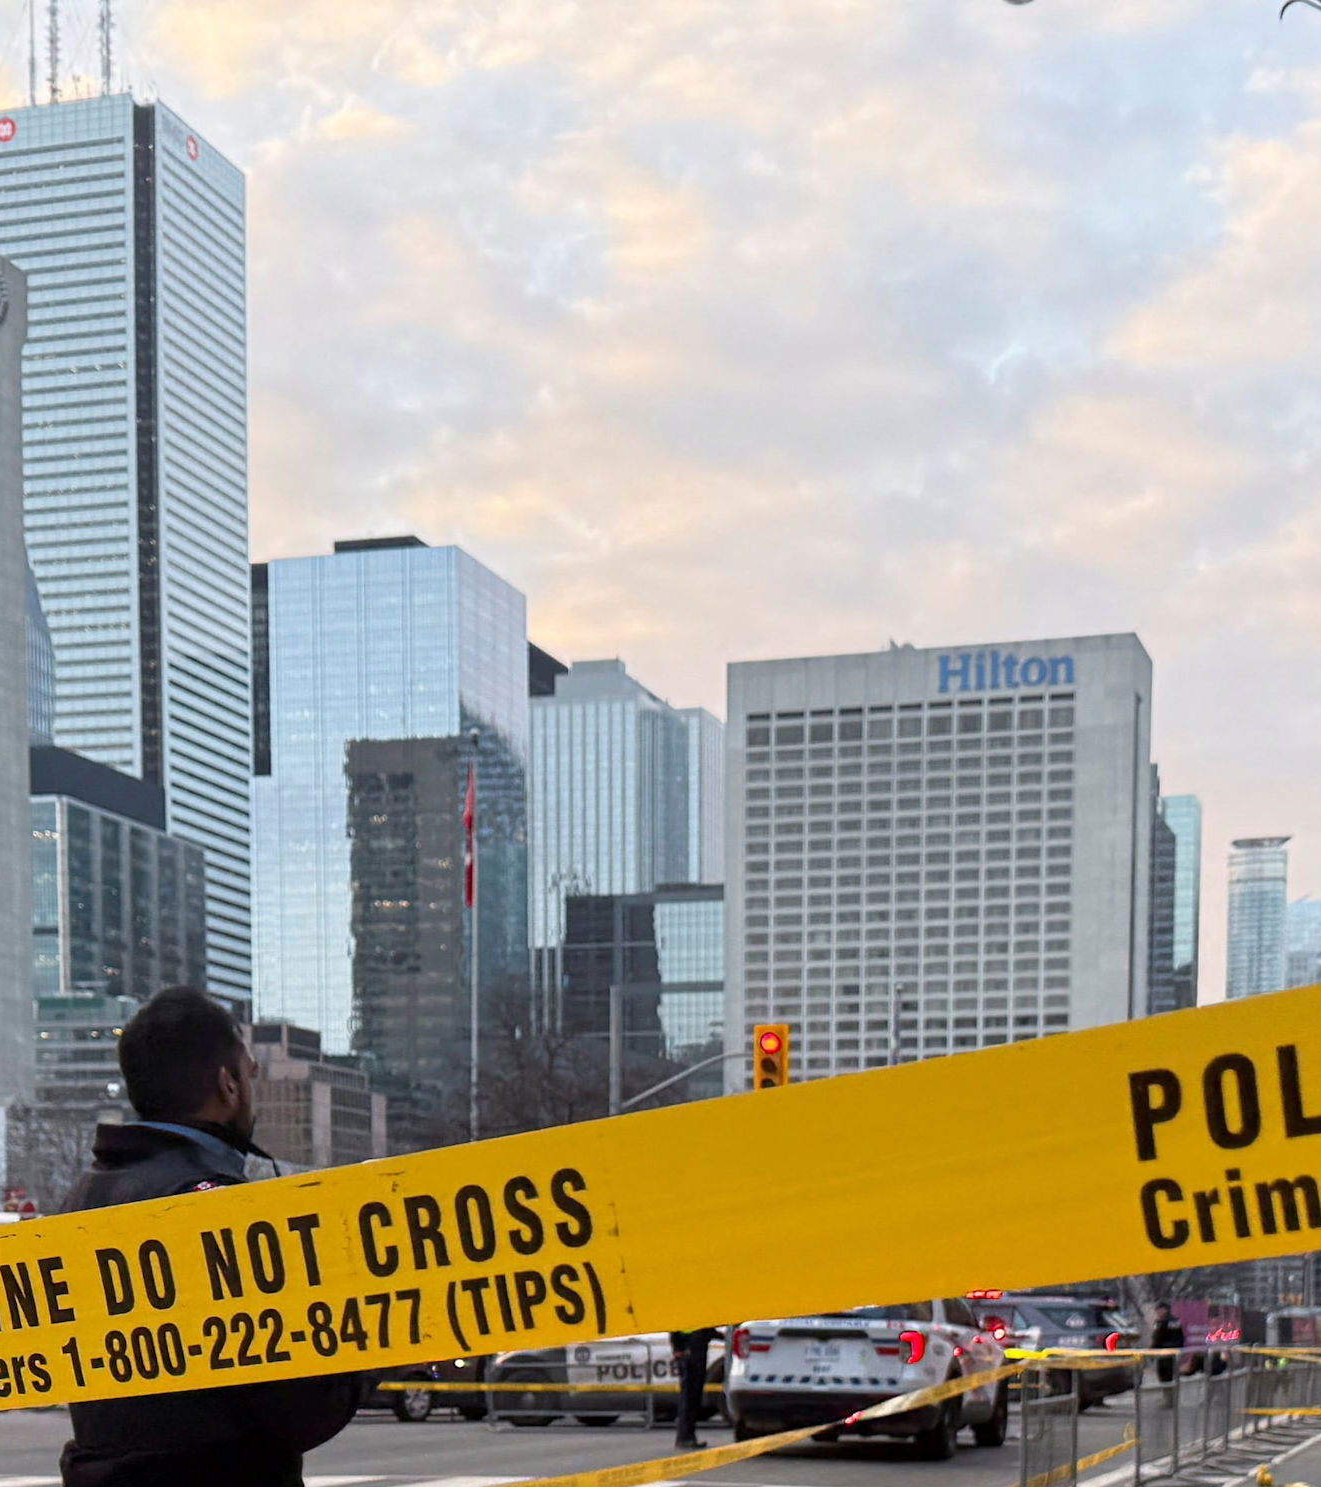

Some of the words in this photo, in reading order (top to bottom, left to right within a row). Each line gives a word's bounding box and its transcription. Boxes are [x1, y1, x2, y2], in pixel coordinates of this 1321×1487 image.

[937, 652, 1075, 694] Hilton
[95, 1239, 176, 1316] DO
[200, 1213, 322, 1301] NOT
[358, 1167, 593, 1278] CROSS
[62, 1288, 421, 1388] 1-800-222-8477
[447, 1261, 607, 1352] (TIPS)
